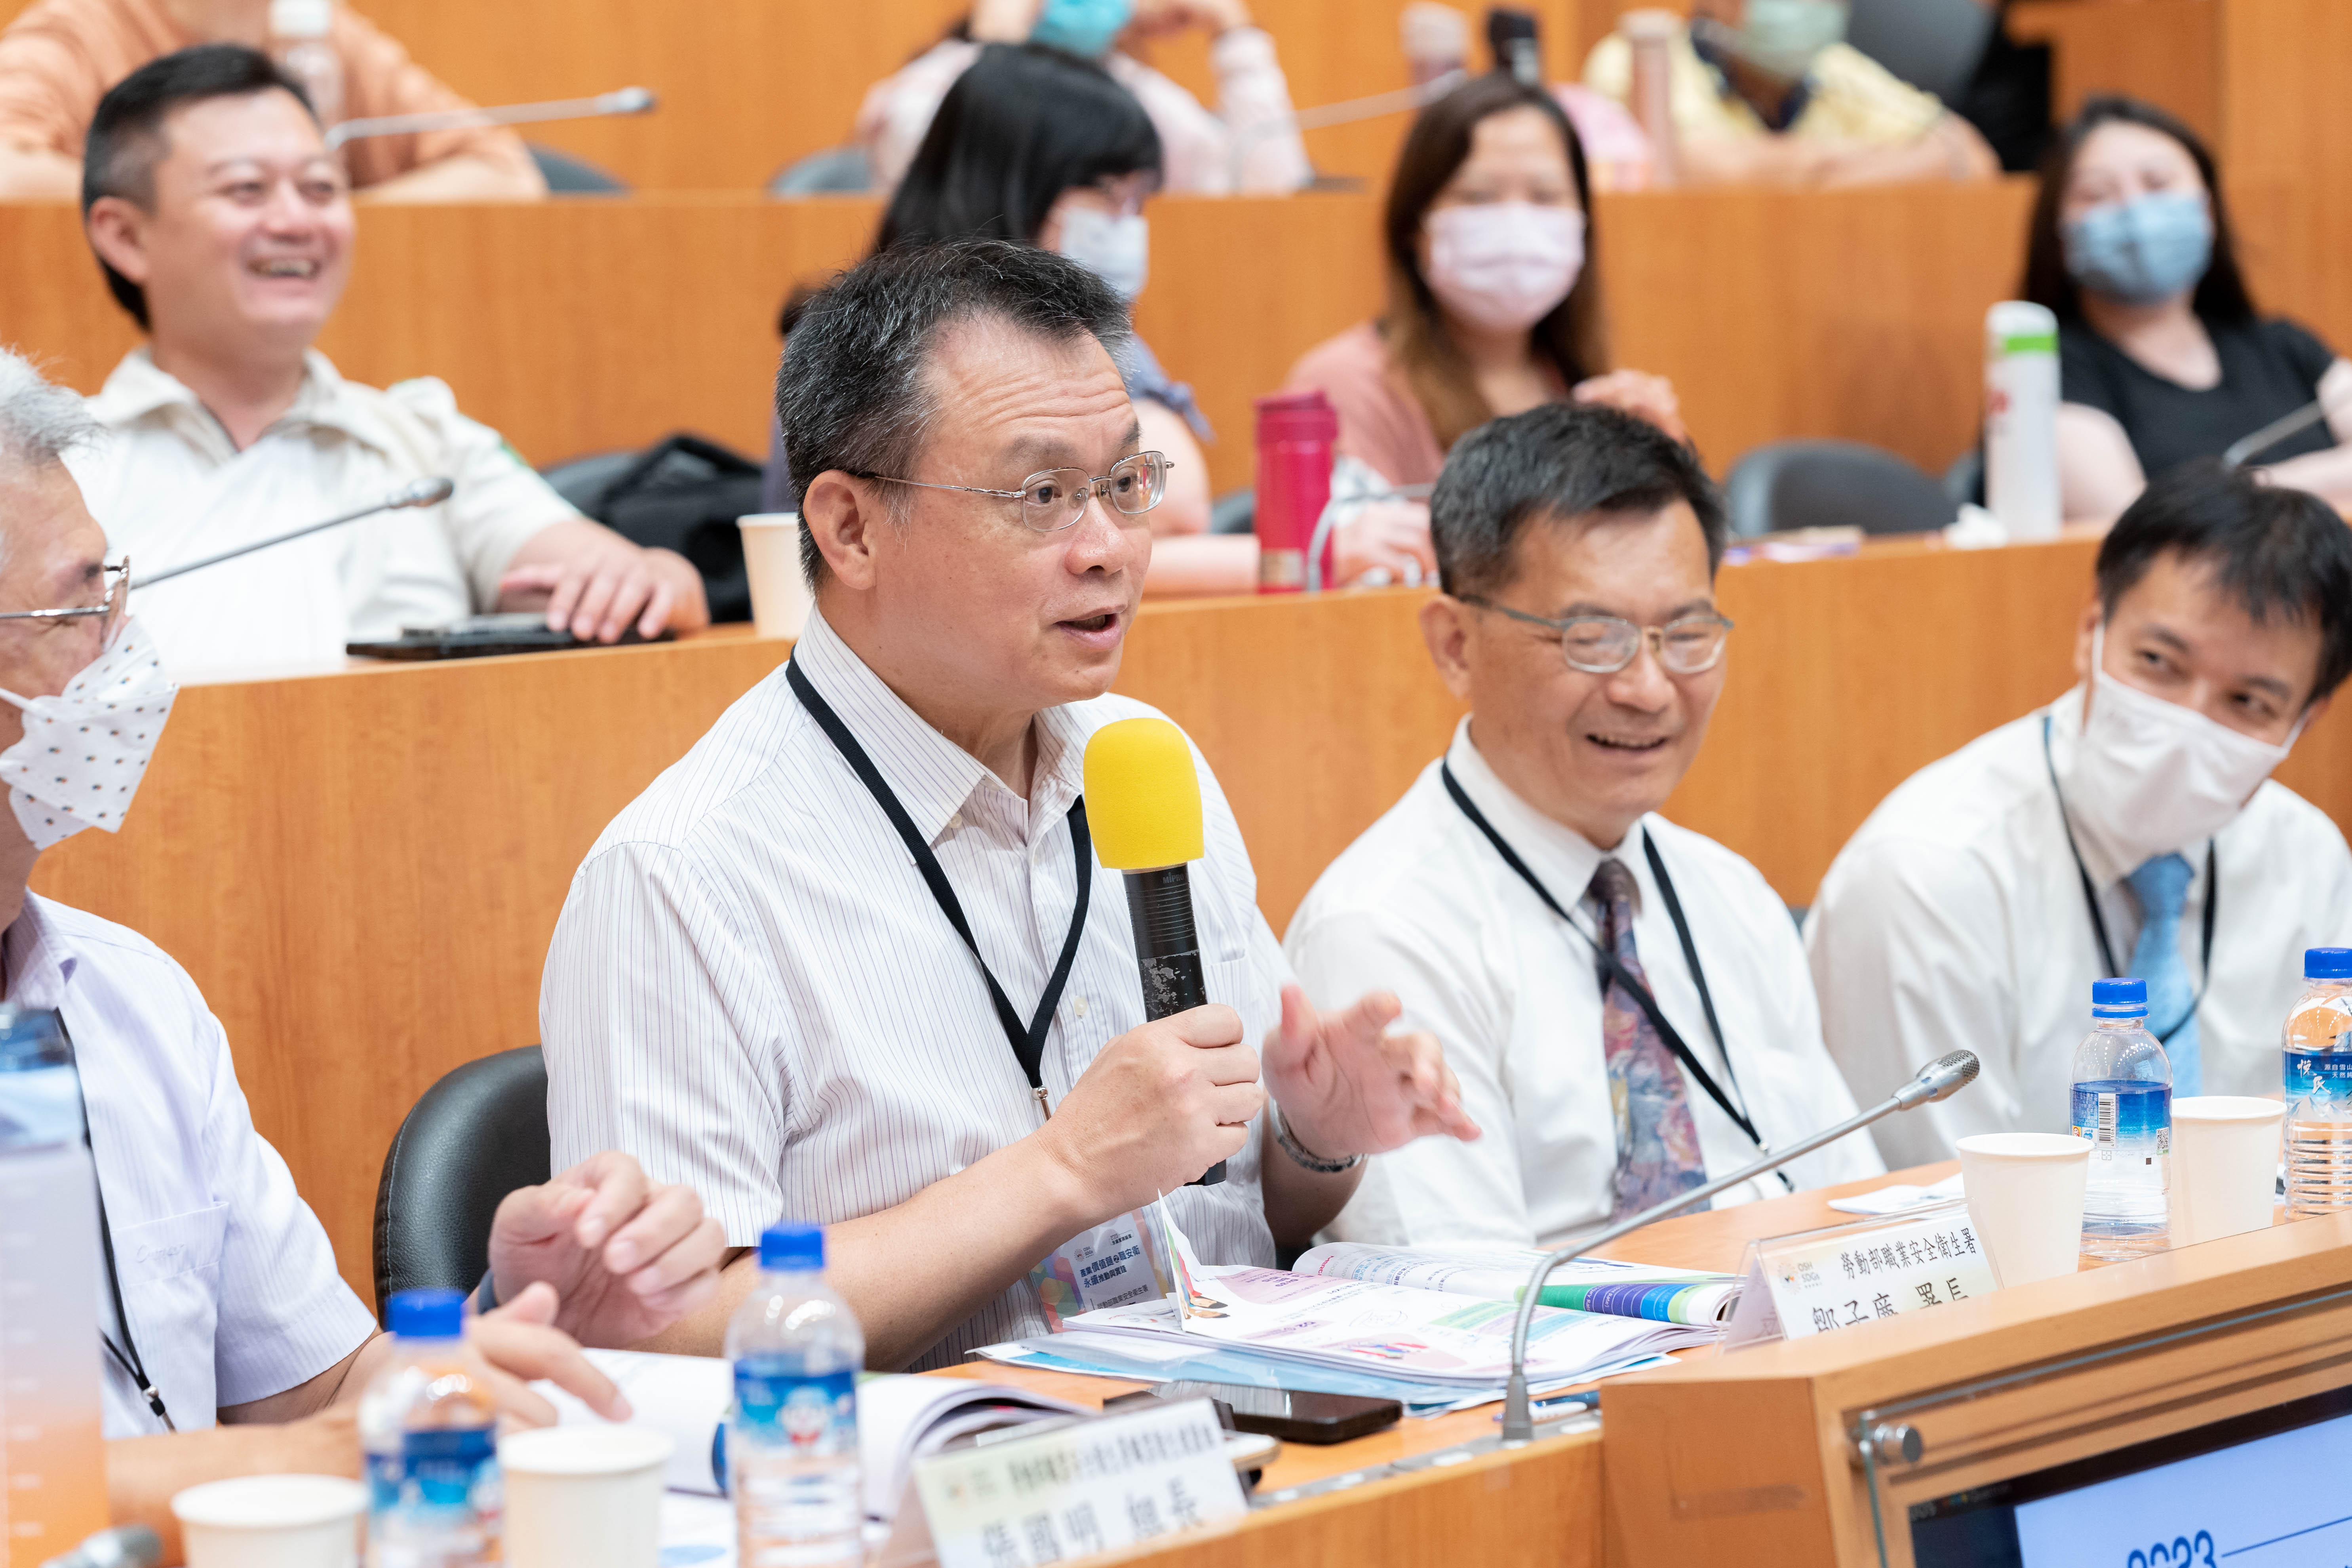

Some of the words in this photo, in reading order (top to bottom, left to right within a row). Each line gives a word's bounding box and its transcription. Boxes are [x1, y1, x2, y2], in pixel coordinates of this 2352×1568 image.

[1840, 1227, 1976, 1279] 勞動部職業安全衛生署
[1084, 1265, 1127, 1288] 永續推動與實踐
